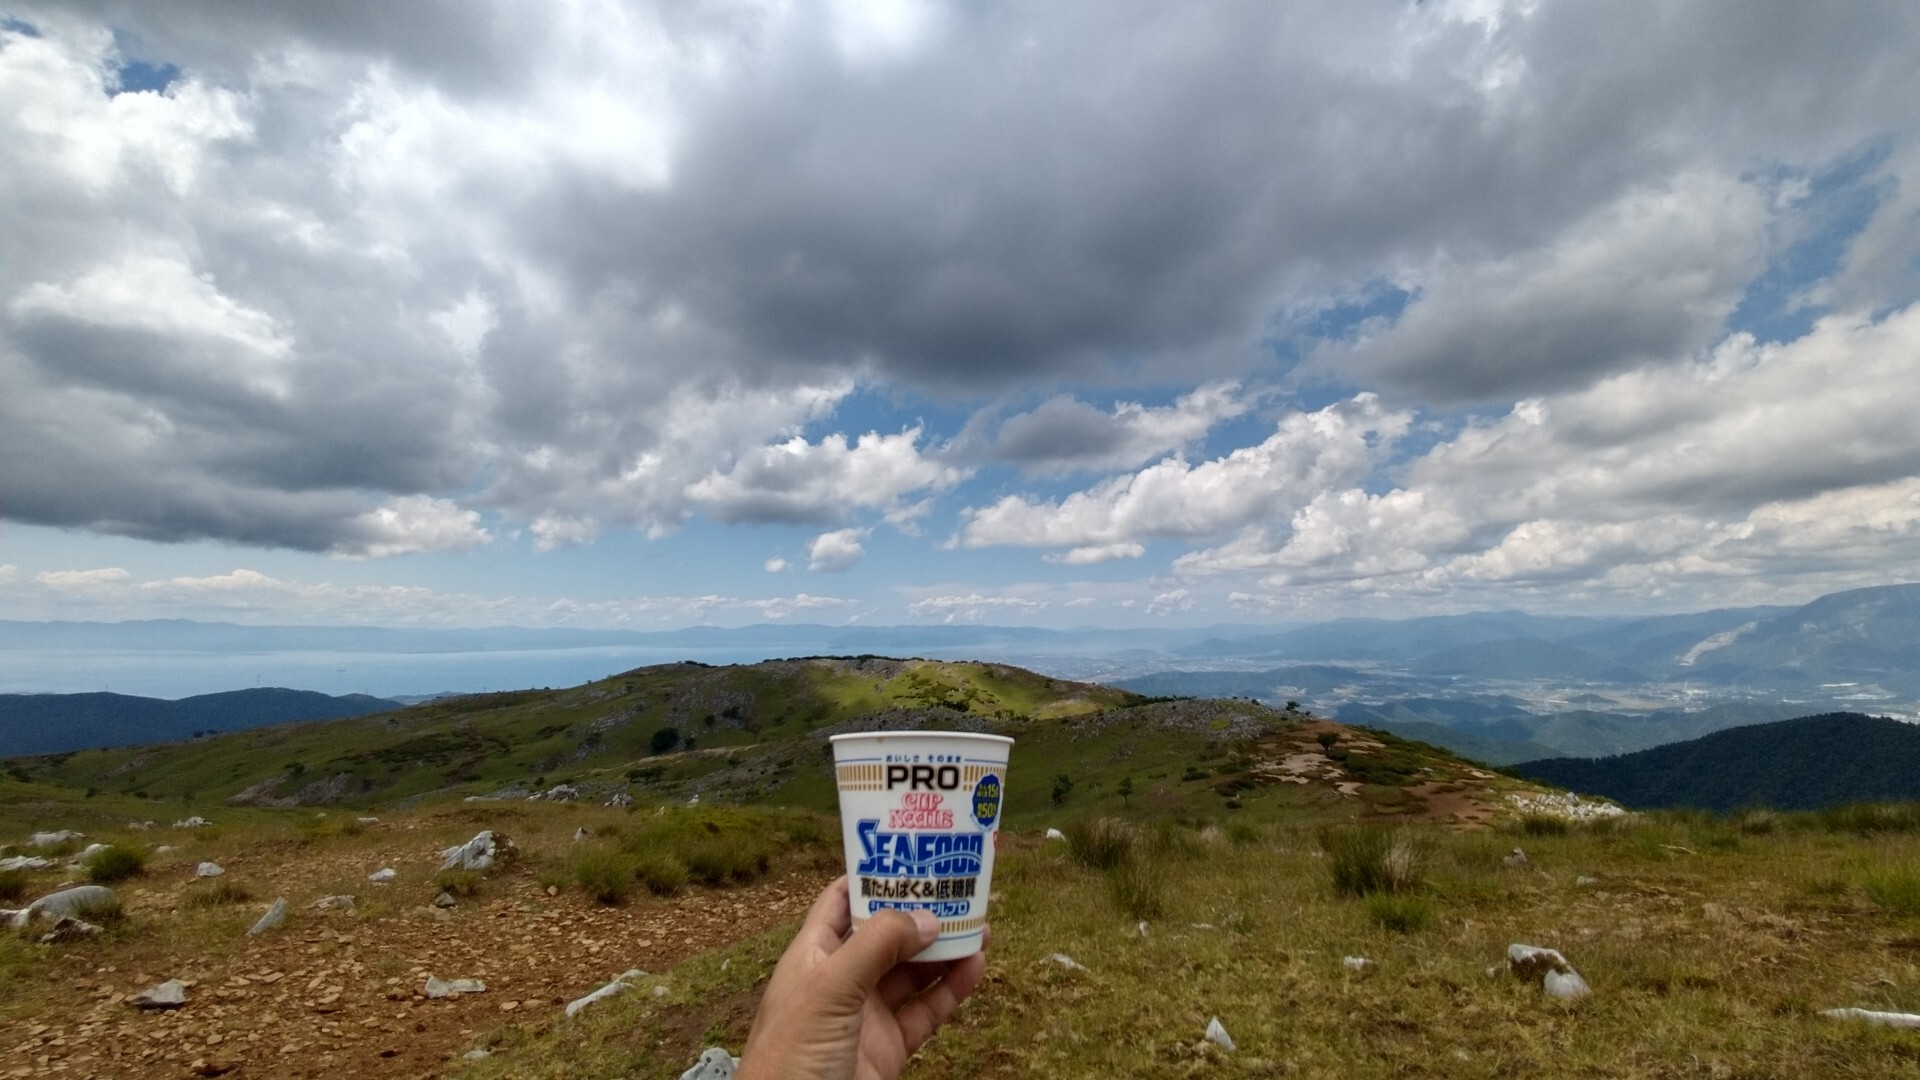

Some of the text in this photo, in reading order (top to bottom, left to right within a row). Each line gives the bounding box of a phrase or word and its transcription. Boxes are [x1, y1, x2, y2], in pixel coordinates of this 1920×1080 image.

[887, 765, 960, 790] PRO
[902, 793, 943, 811] CUP
[857, 820, 983, 877] SEAFOOD
